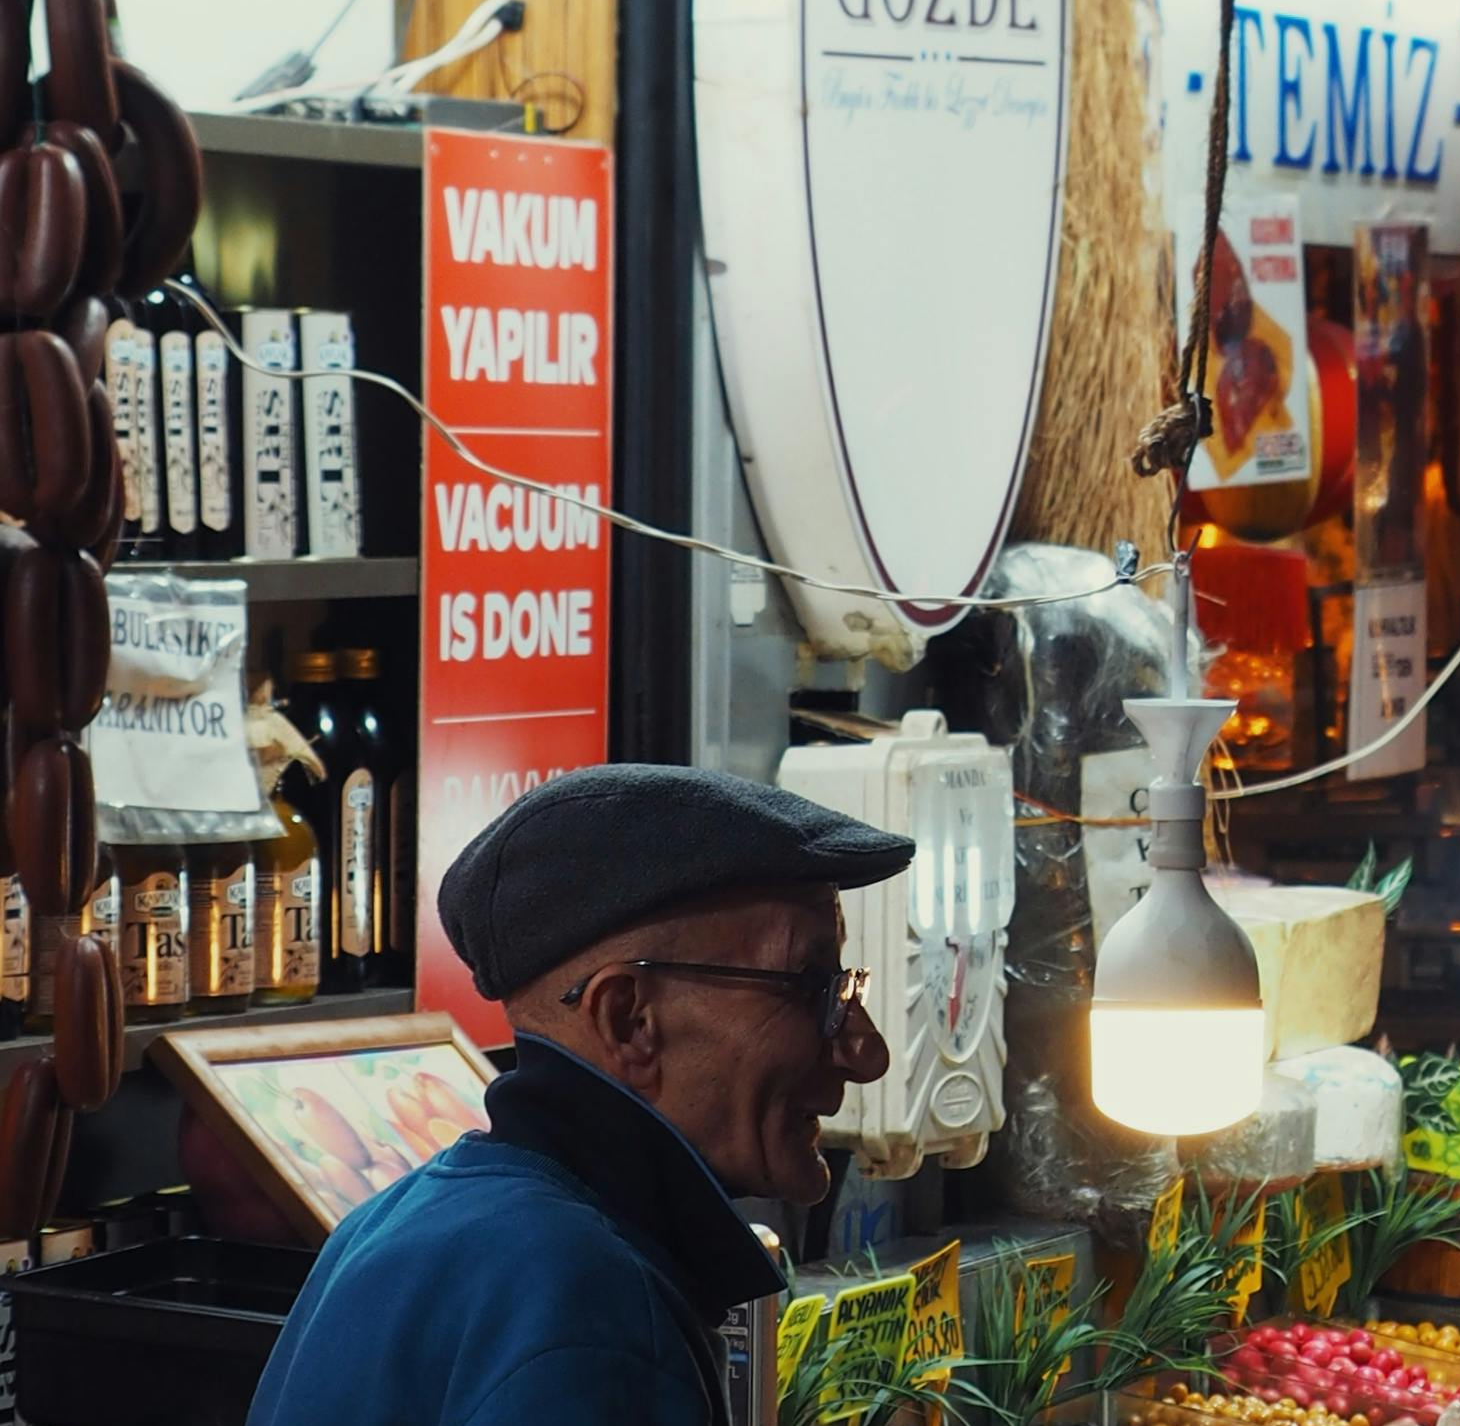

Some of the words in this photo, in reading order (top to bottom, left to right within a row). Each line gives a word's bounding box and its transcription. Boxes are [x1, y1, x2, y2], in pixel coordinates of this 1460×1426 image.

[1233, 1, 1443, 184] TEMİZ
[444, 186, 597, 271] VAKUM
[441, 305, 596, 385] YAPILIR
[434, 483, 599, 553] VACUUM
[440, 592, 480, 663] IS
[484, 589, 592, 655] DONE
